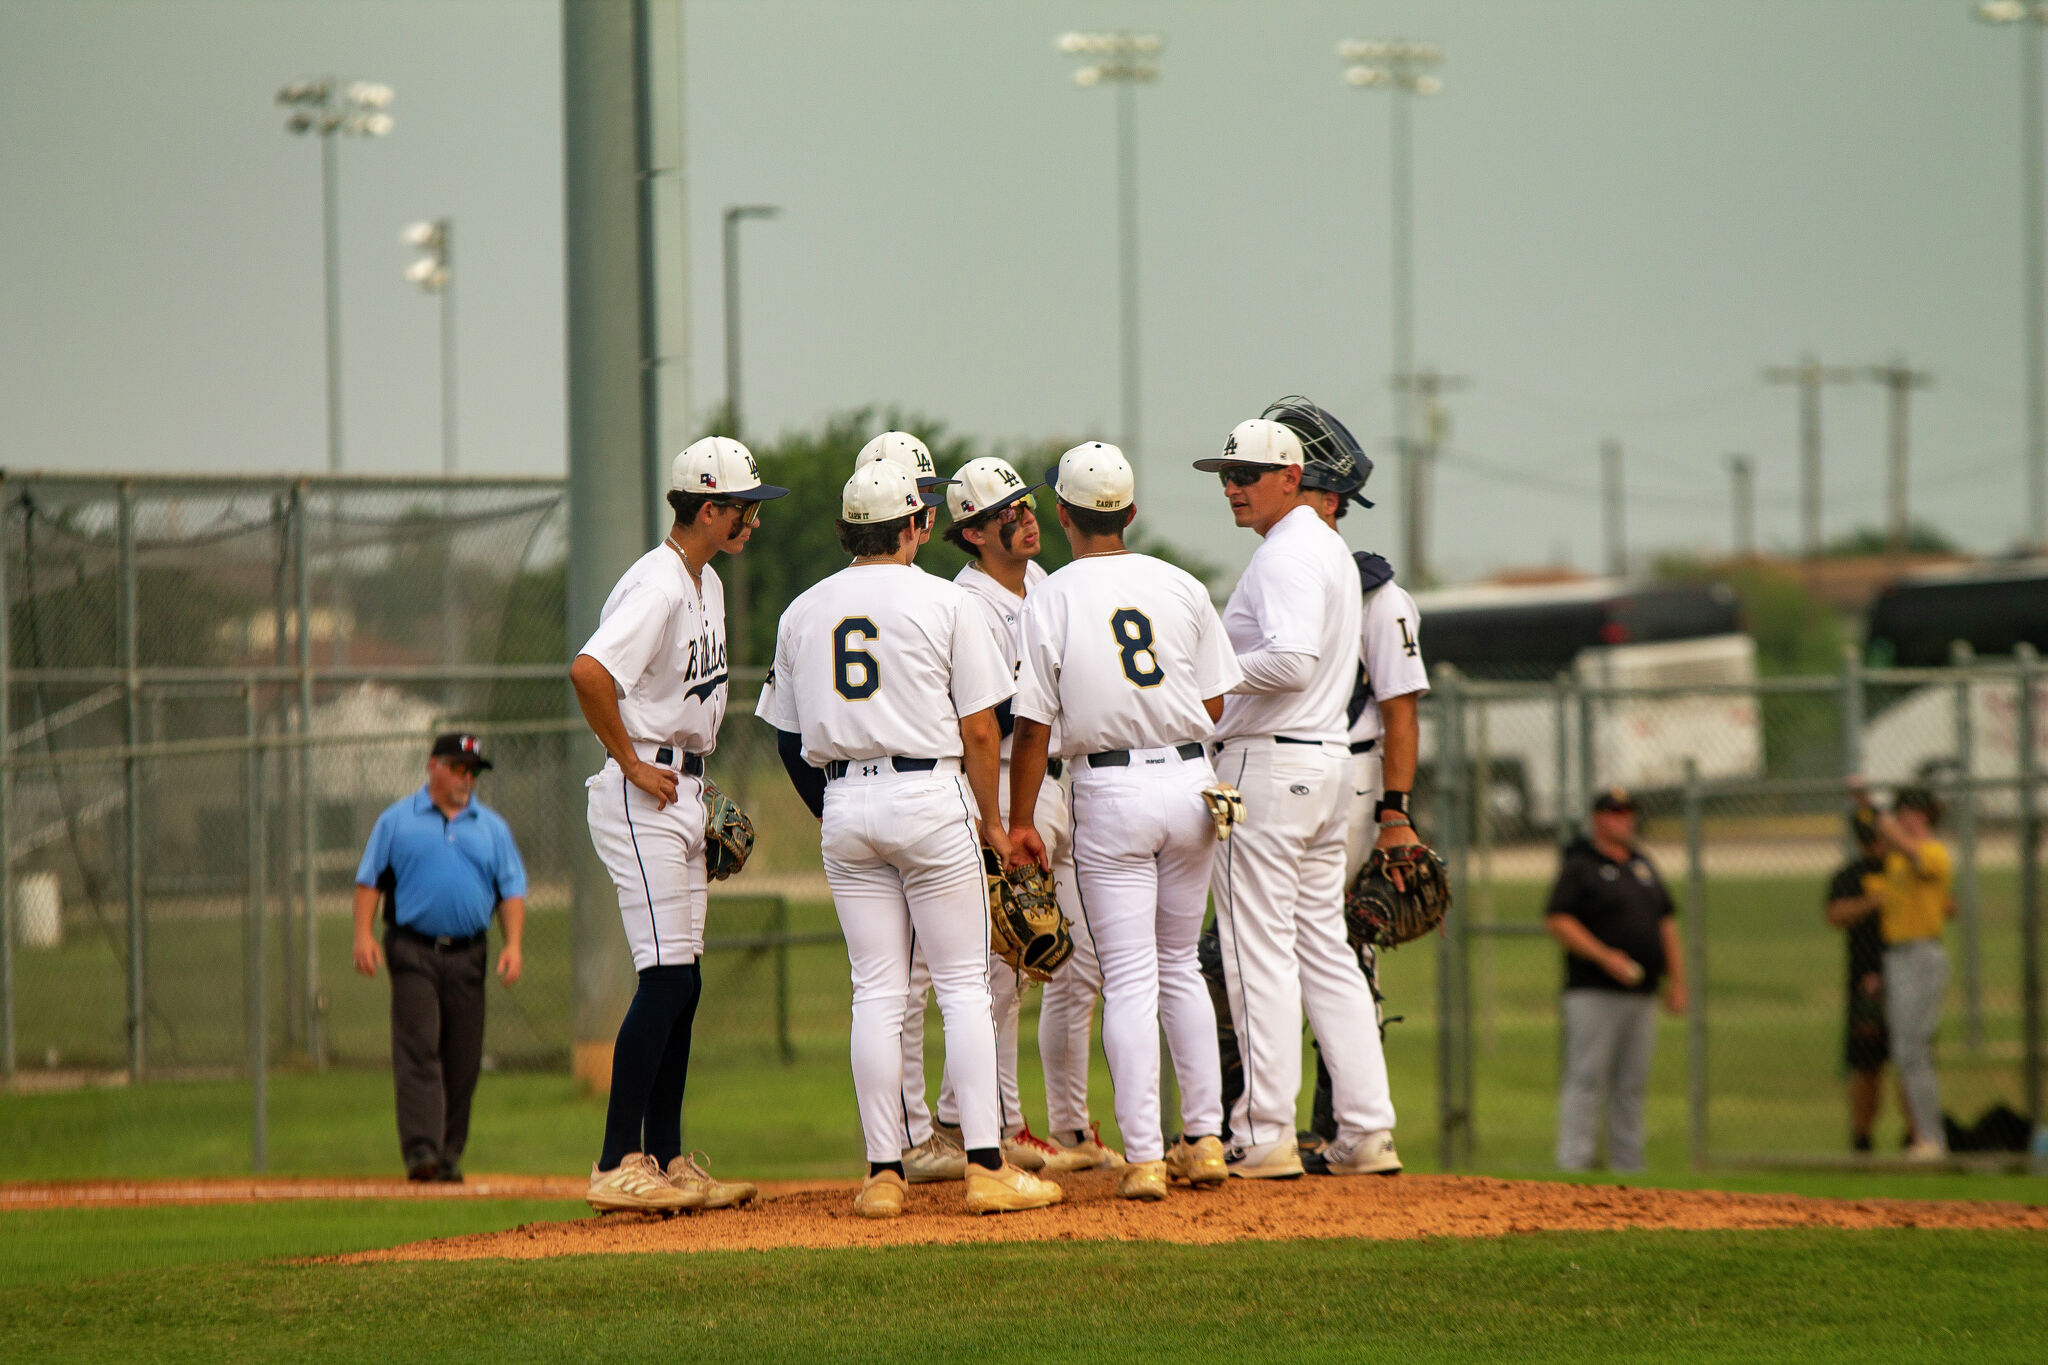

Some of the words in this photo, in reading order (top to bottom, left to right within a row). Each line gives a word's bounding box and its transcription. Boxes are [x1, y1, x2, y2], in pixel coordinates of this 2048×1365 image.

[1223, 433, 1238, 456] LA
[744, 455, 760, 480] LA
[912, 449, 933, 473] LA
[994, 468, 1020, 487] LA
[1095, 499, 1113, 508] EARN
[1114, 499, 1121, 508] IT
[832, 615, 882, 703] 6
[1109, 606, 1166, 690] 8
